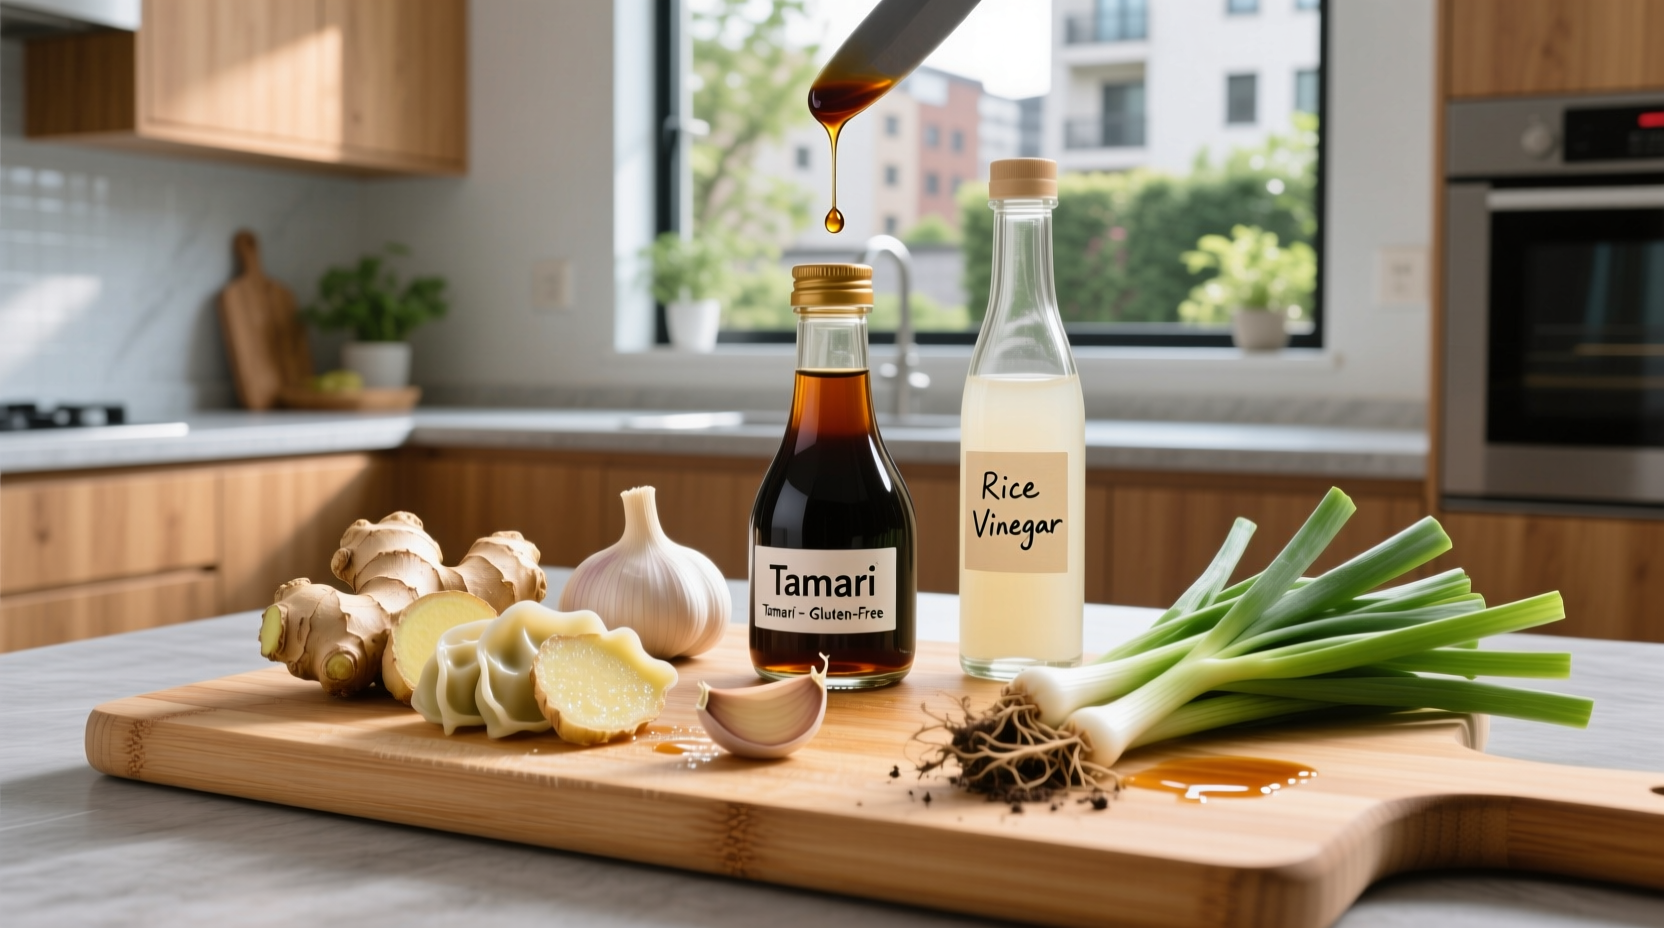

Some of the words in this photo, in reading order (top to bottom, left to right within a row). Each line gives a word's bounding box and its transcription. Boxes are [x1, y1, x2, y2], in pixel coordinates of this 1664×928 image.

[981, 470, 1040, 501] Rice
[972, 508, 1063, 551] Vinegar
[769, 563, 876, 598] Tamari
[808, 605, 884, 621] Gluten-Free
